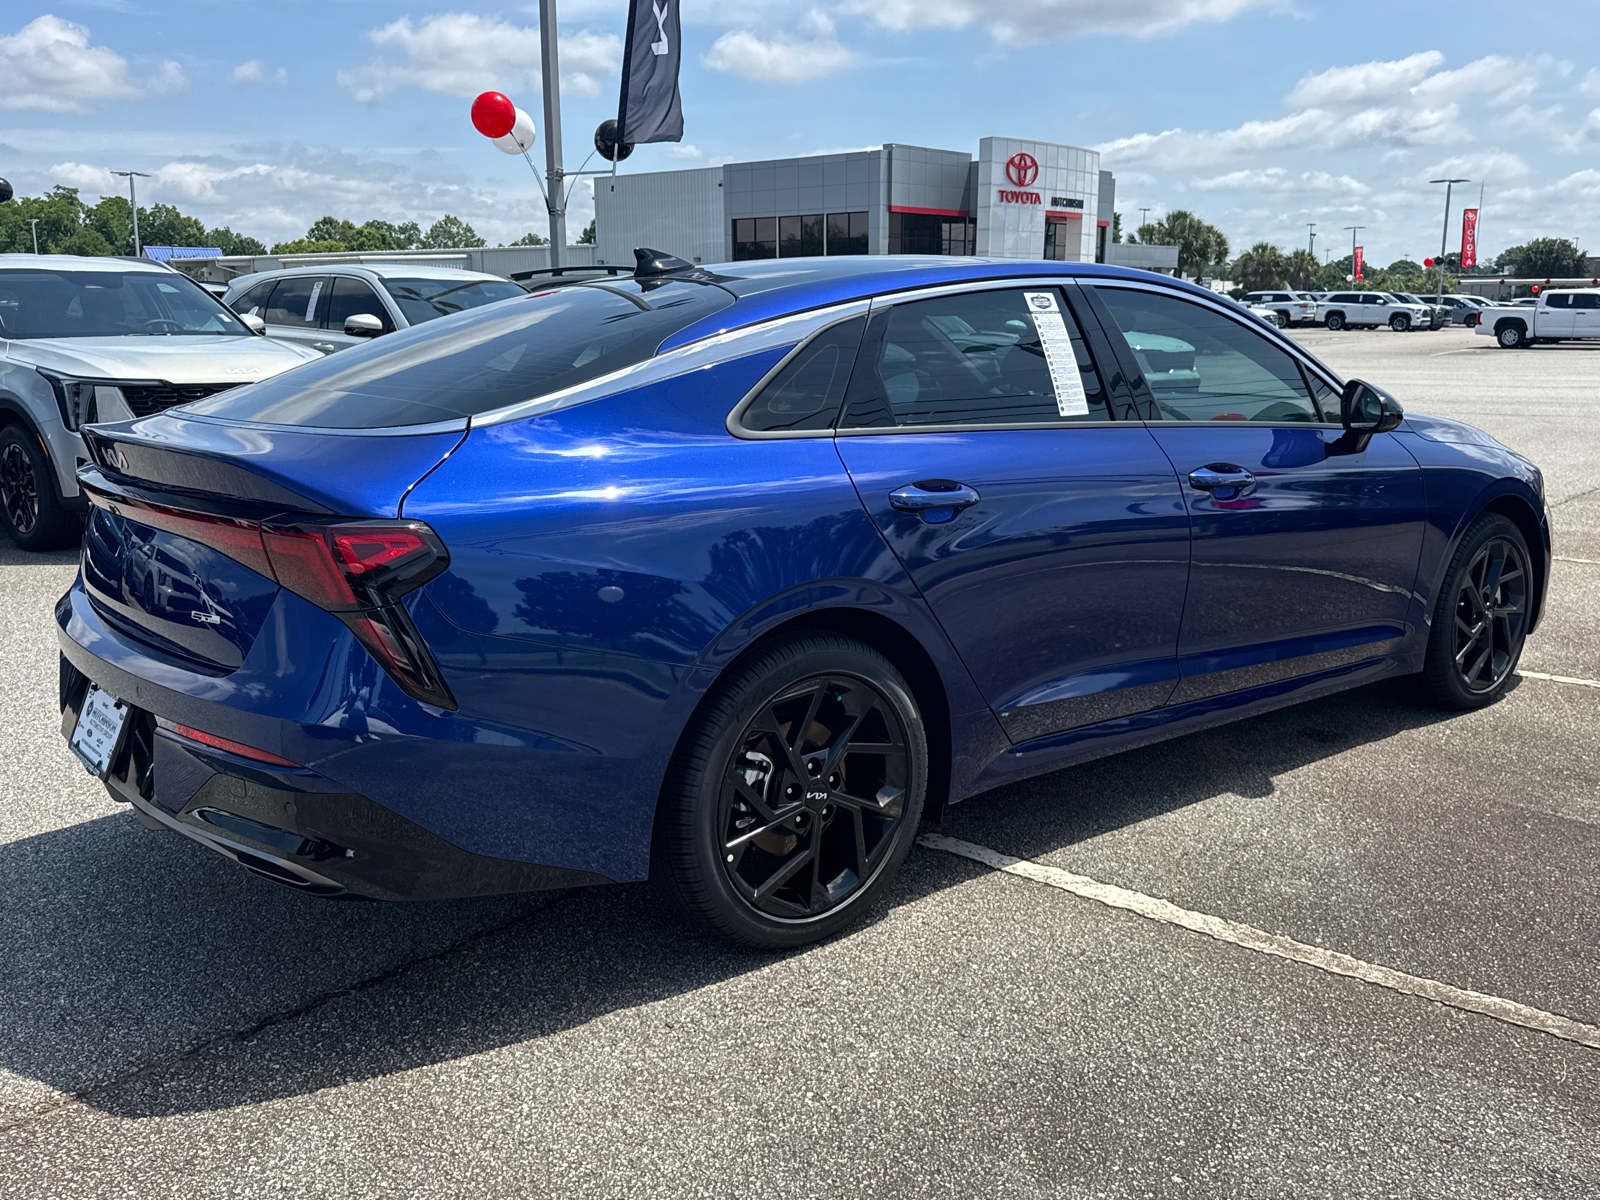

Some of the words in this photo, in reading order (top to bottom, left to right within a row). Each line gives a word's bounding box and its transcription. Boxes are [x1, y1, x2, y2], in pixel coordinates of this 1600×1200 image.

[999, 190, 1042, 205] TOYOTA
[101, 446, 129, 470] KIA
[806, 791, 828, 800] KIA
